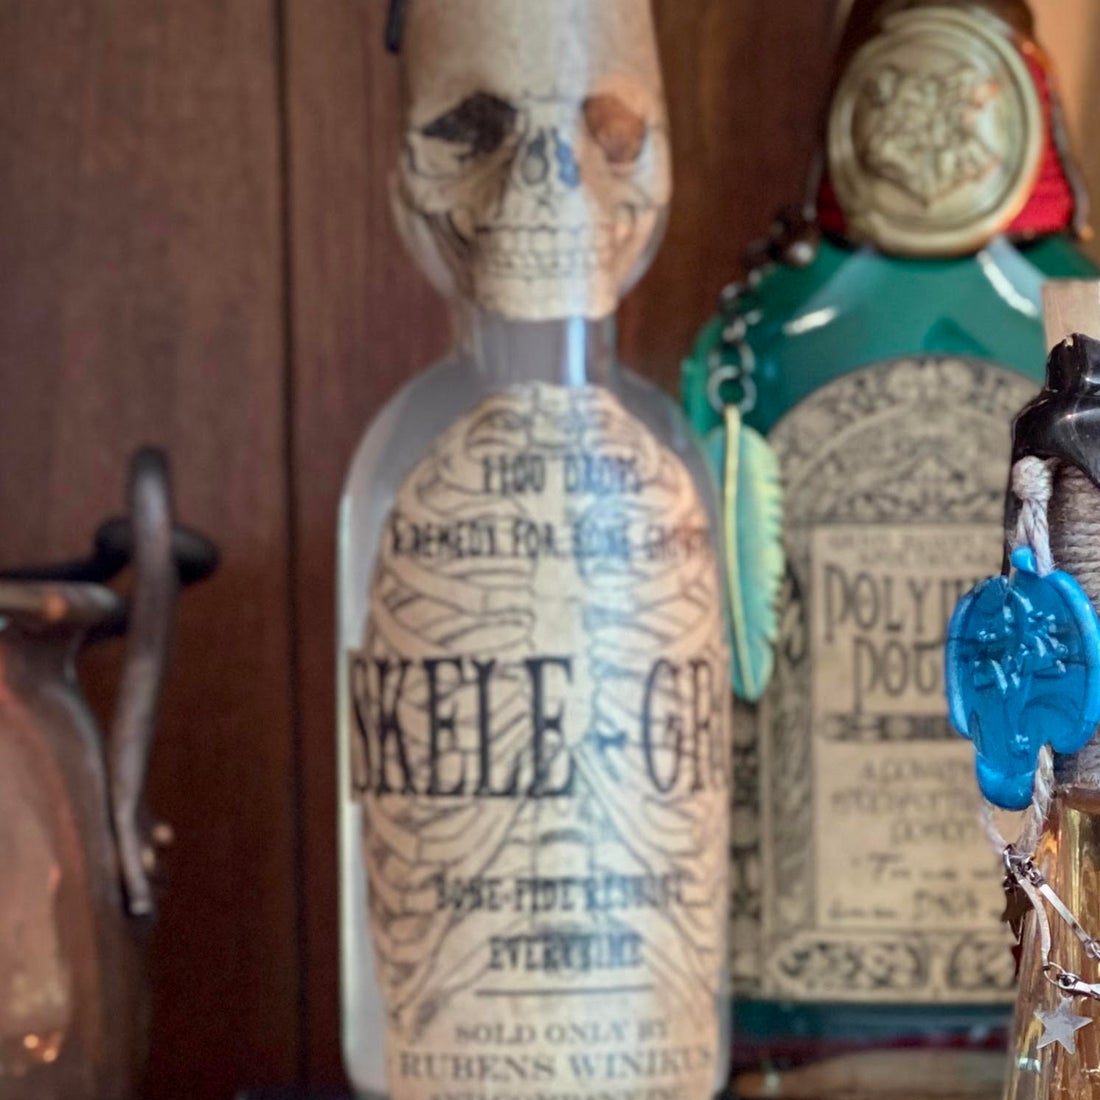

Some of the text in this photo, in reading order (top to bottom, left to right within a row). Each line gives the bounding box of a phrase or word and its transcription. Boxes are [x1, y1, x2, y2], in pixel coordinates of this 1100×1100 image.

[455, 1022, 537, 1047] SOLD
[545, 1019, 627, 1046] ONLY
[399, 1050, 557, 1083] RUBENS
